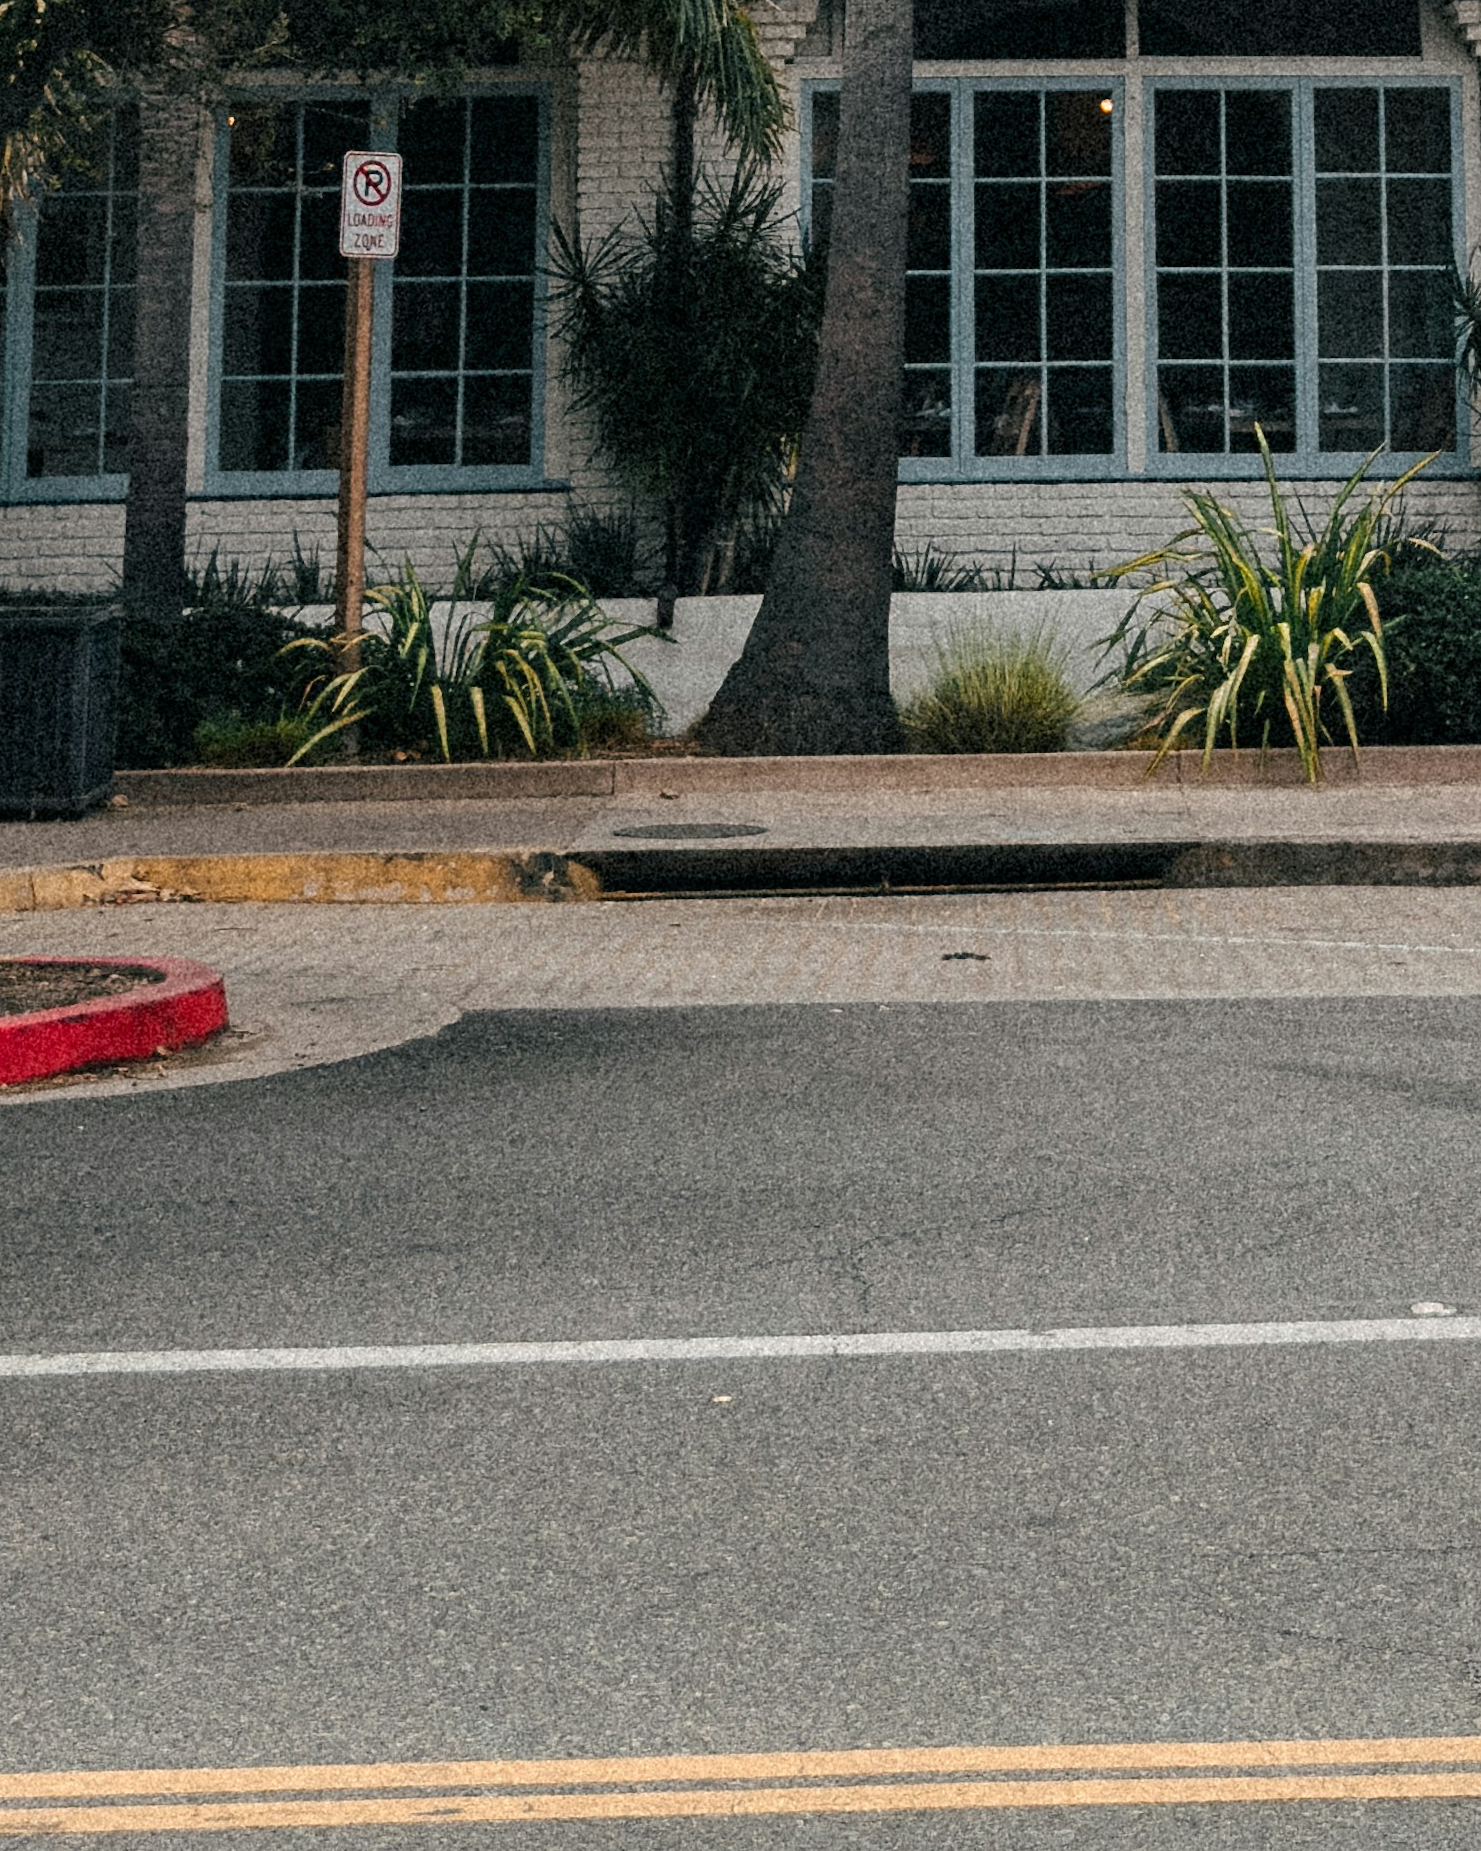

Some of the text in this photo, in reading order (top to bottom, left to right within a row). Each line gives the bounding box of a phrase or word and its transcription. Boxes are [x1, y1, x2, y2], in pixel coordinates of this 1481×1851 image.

[365, 170, 383, 196] P
[347, 212, 393, 228] LOADING
[354, 233, 384, 248] ZONE
